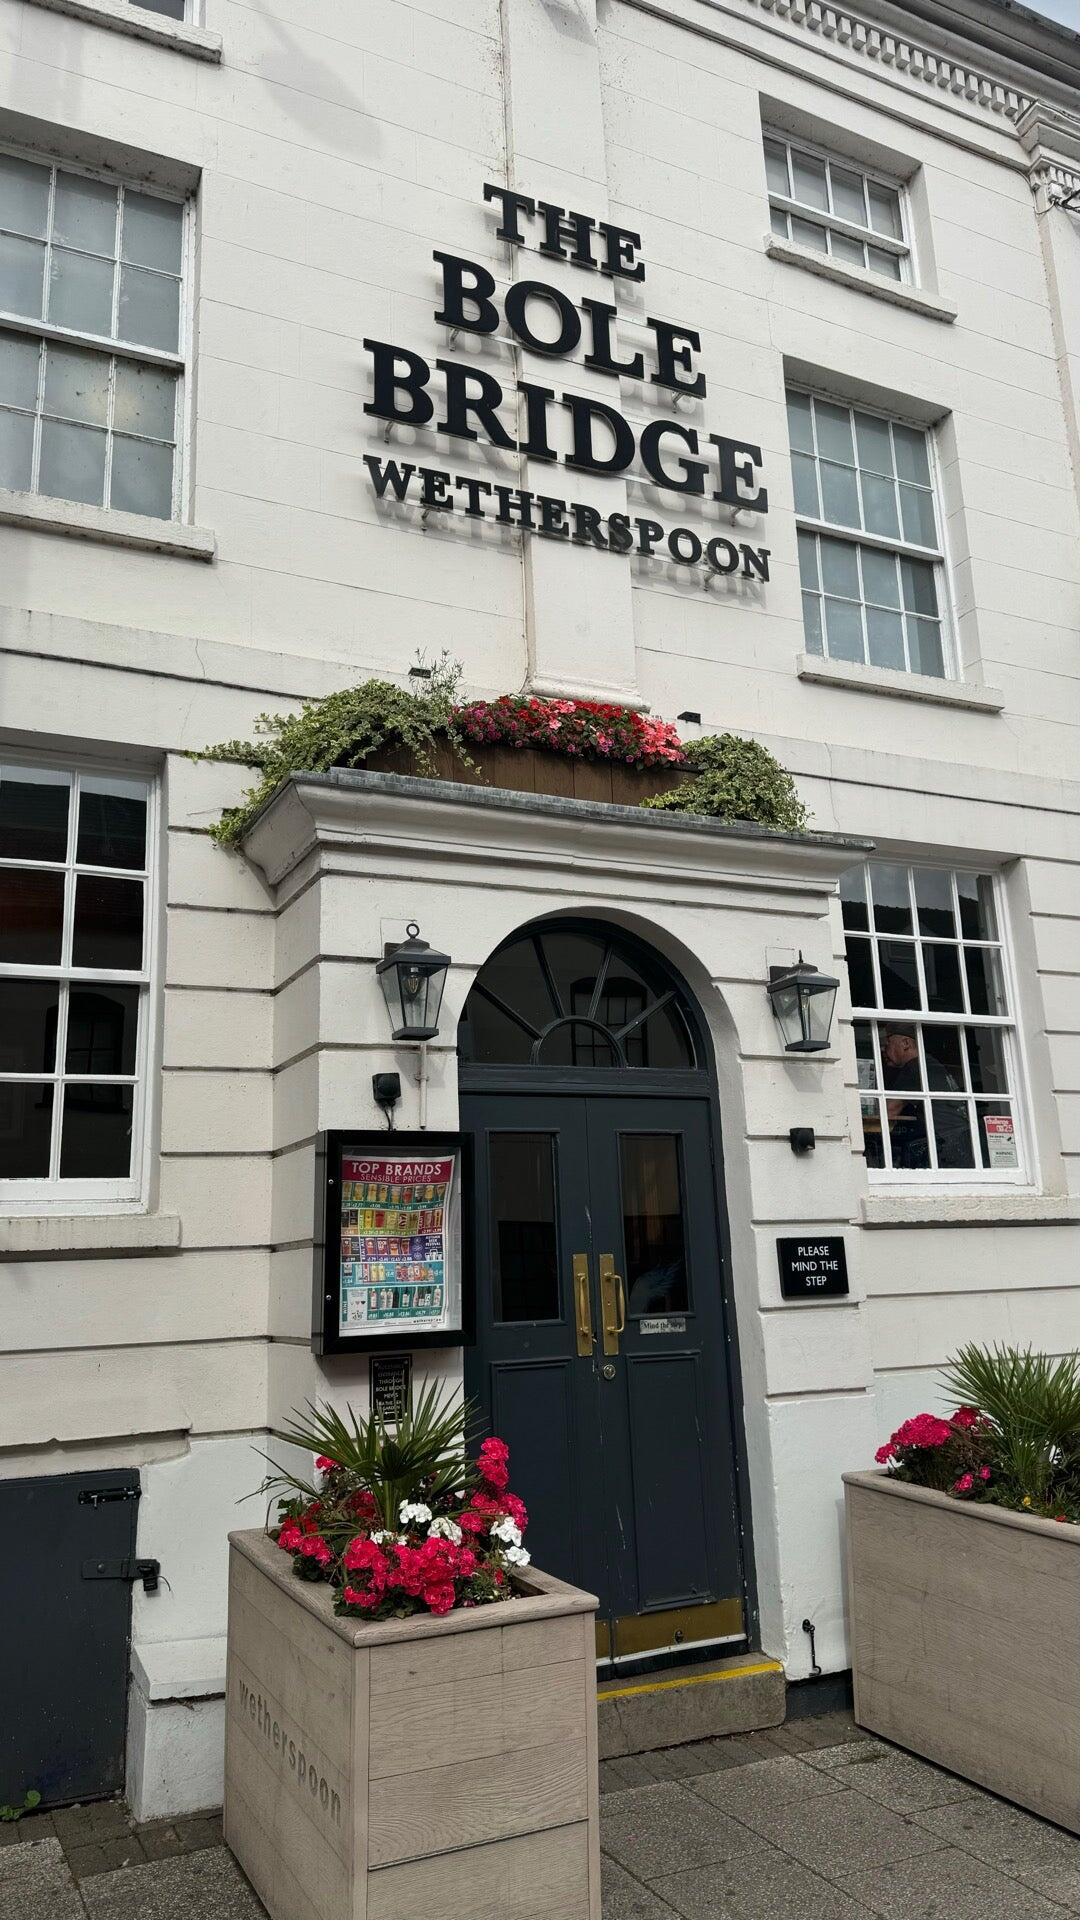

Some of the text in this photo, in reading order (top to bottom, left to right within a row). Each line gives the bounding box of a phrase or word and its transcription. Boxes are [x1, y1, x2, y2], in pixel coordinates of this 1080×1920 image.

[483, 182, 646, 283] THE
[432, 249, 707, 399] BOLE
[363, 338, 769, 514] BRIDGE
[363, 454, 771, 582] WETHERSPOON
[352, 1162, 442, 1176] TOP BRANDS
[360, 1173, 432, 1184] SENSIBLE PRICES
[797, 1246, 830, 1256] PLEASE
[791, 1260, 839, 1271] MIND THE
[805, 1276, 827, 1286] STEP
[643, 1321, 659, 1329] Mind
[660, 1321, 669, 1329] the
[239, 1680, 341, 1828] wetherspoon
